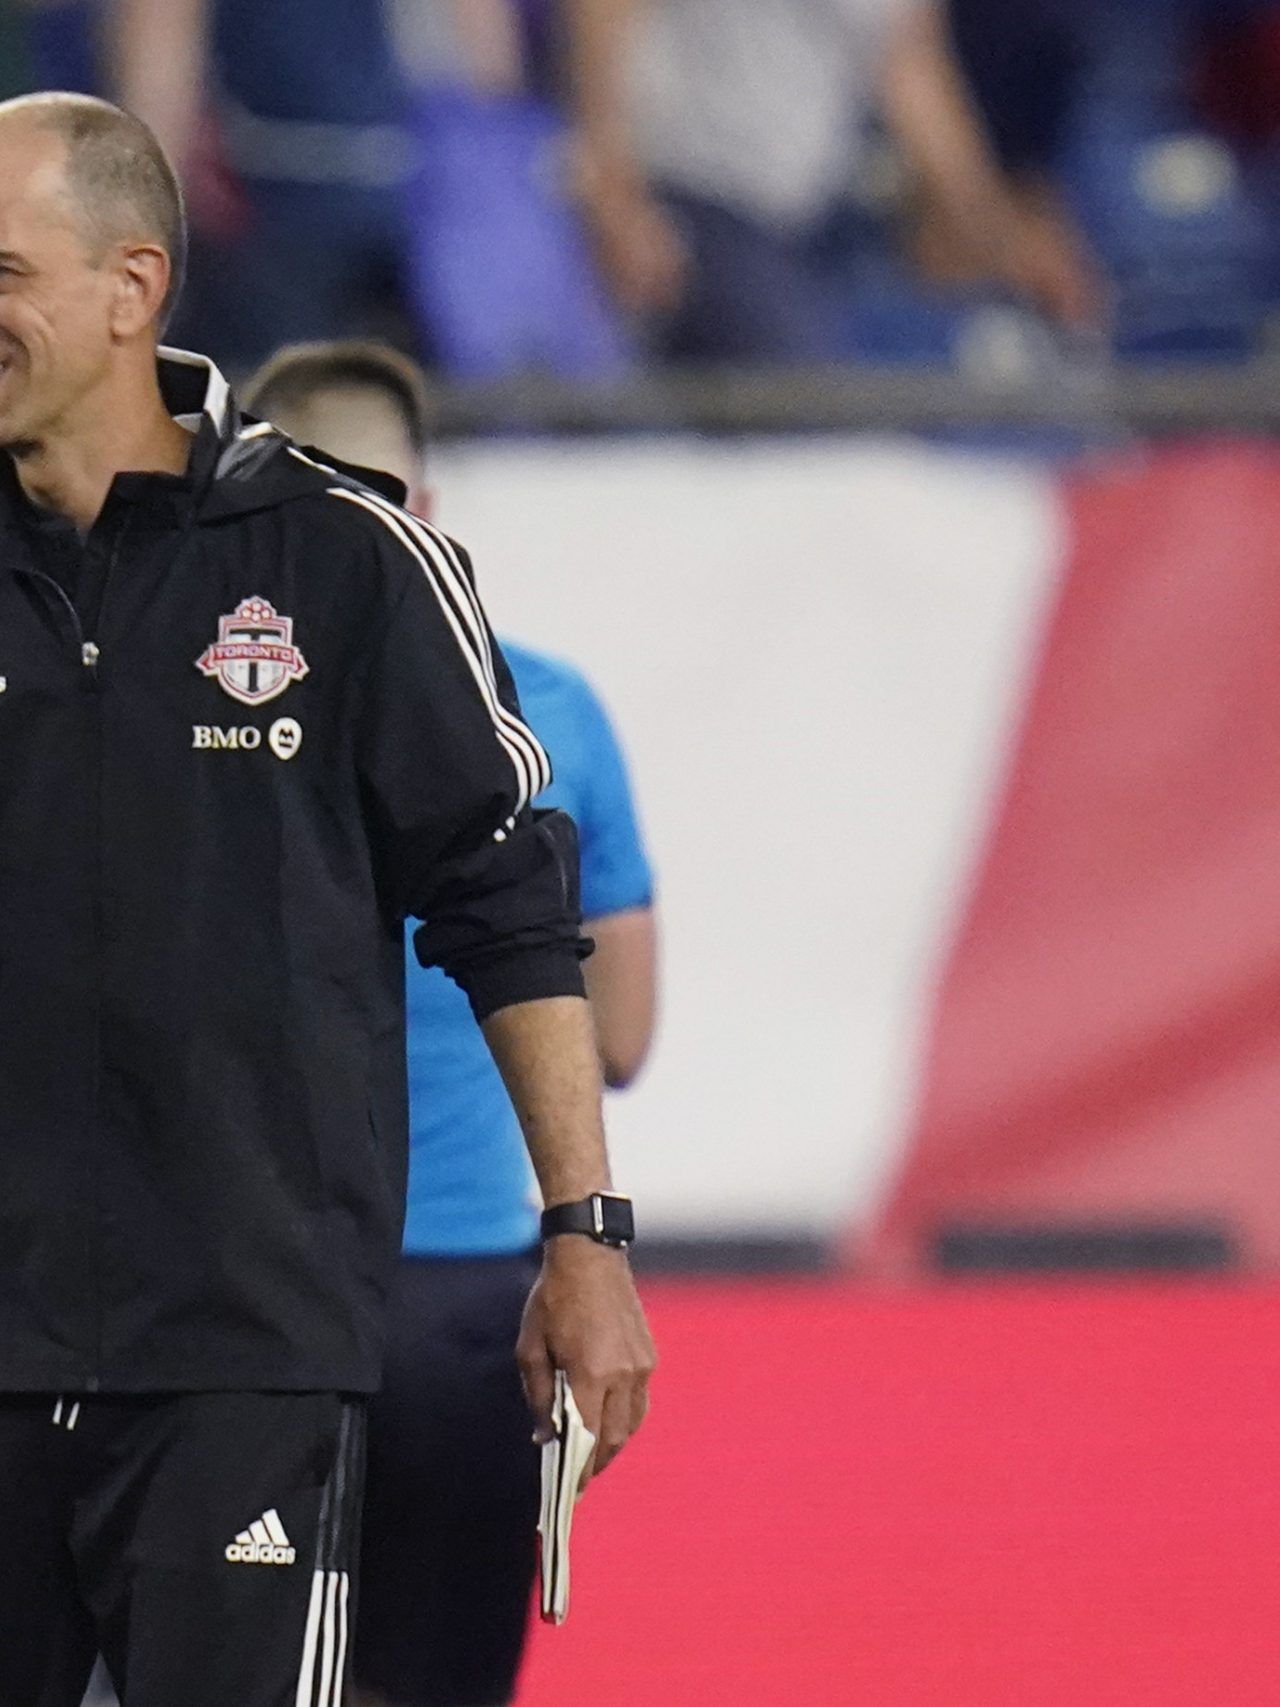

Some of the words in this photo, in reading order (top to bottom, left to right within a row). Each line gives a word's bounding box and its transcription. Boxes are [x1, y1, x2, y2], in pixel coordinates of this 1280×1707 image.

[215, 644, 293, 661] TORONTO
[192, 725, 262, 749] BMO
[225, 1543, 296, 1565] adidas
